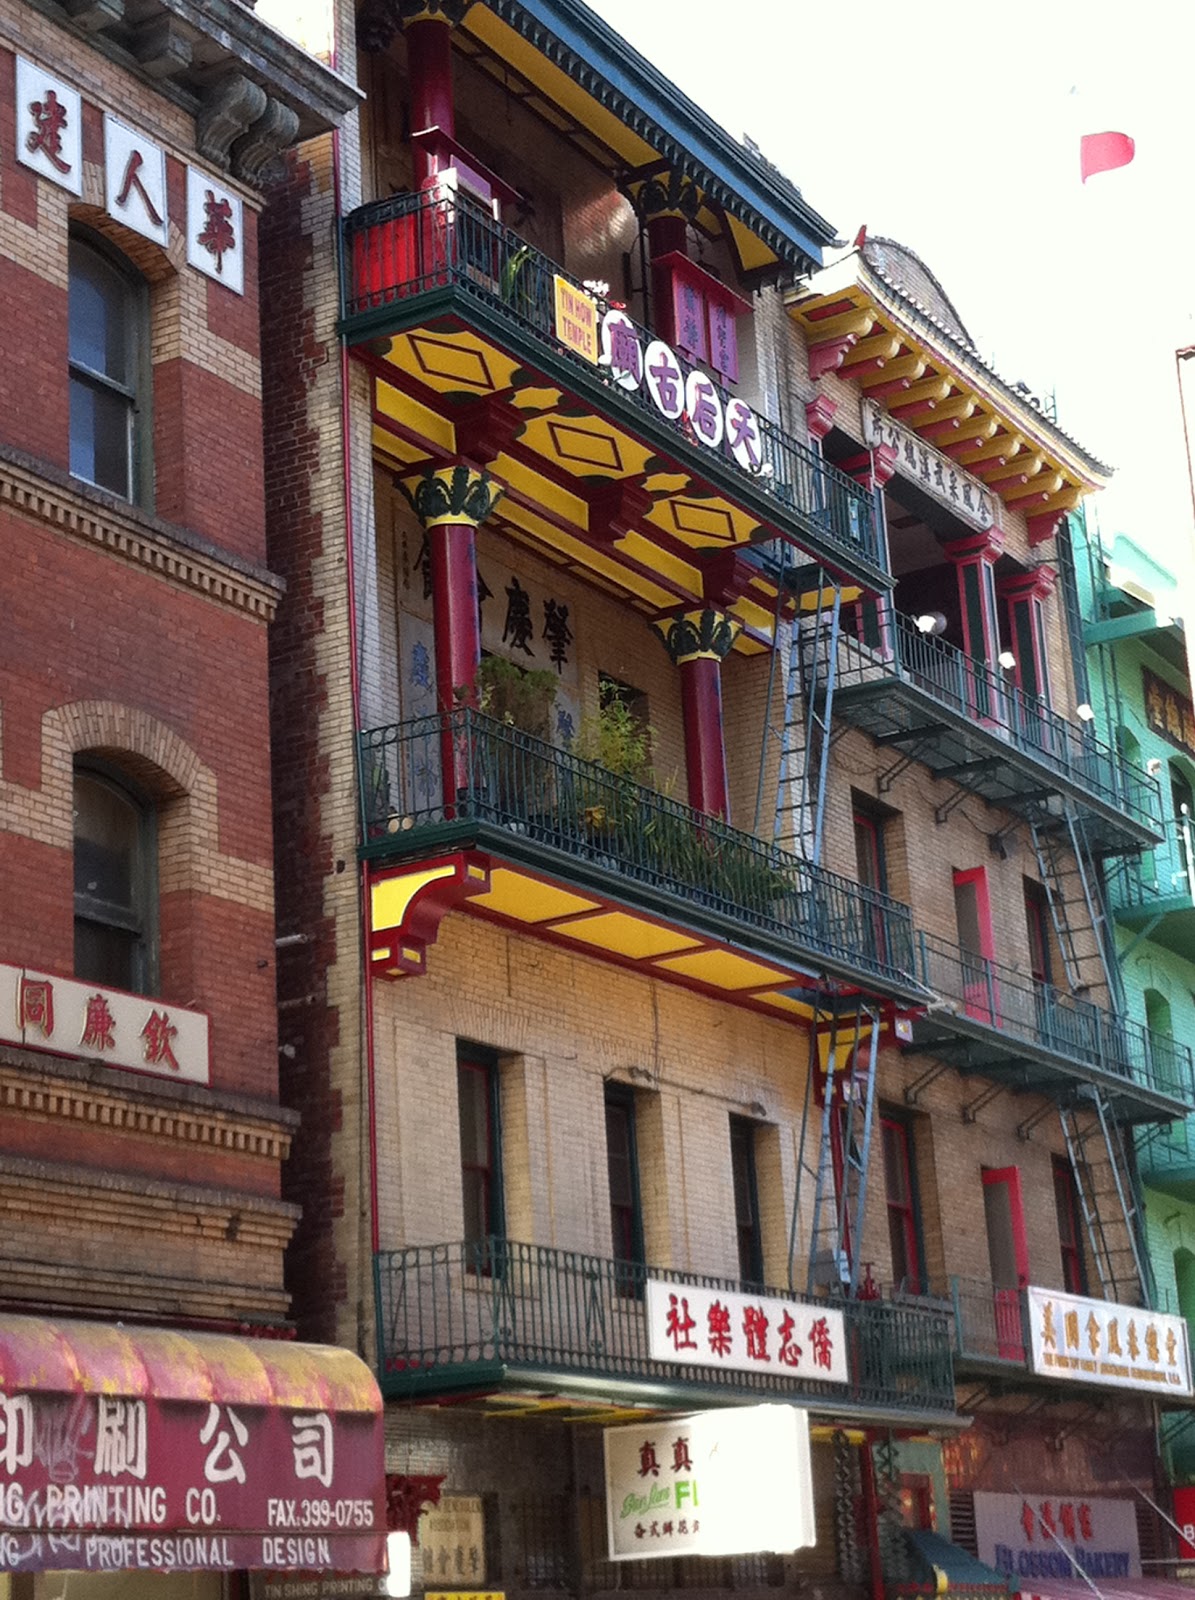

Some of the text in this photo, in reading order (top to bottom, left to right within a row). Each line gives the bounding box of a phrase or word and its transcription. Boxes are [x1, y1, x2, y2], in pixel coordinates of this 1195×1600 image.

[562, 316, 592, 355] TEMPLE
[47, 1484, 167, 1525] PRINTING
[185, 1487, 222, 1525] CO.
[86, 1537, 234, 1568] PROFESSIONAL
[262, 1537, 331, 1565] DESIGN
[322, 1578, 373, 1594] PRINTING
